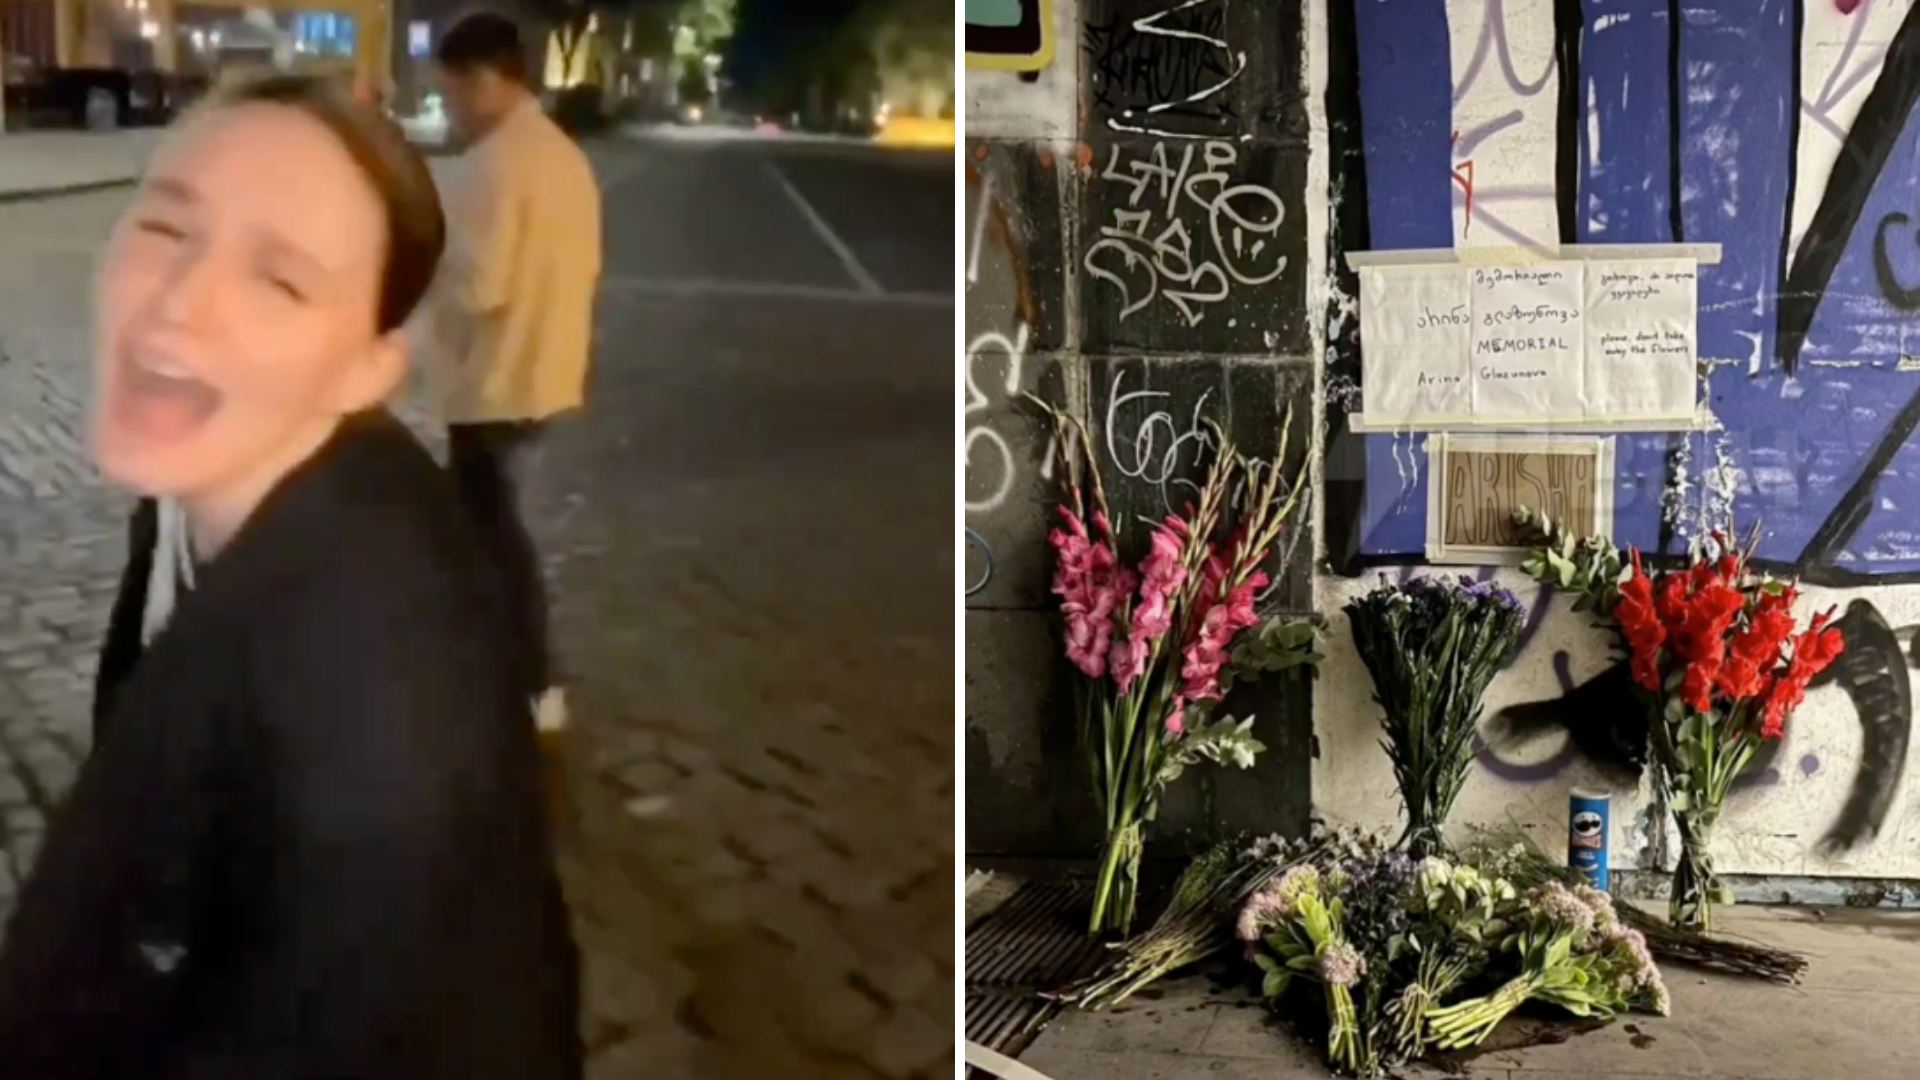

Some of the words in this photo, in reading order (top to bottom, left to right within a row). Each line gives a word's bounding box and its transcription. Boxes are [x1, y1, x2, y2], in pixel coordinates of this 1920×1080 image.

[1417, 304, 1470, 328] არინა
[1483, 304, 1579, 325] გლაზუნოვა
[1664, 331, 1684, 340] take
[1476, 337, 1568, 355] MEMORIAL
[1631, 345, 1646, 354] the
[1417, 371, 1461, 386] Arina
[1480, 366, 1547, 381] Glazunova
[1446, 452, 1595, 545] ARISHA
